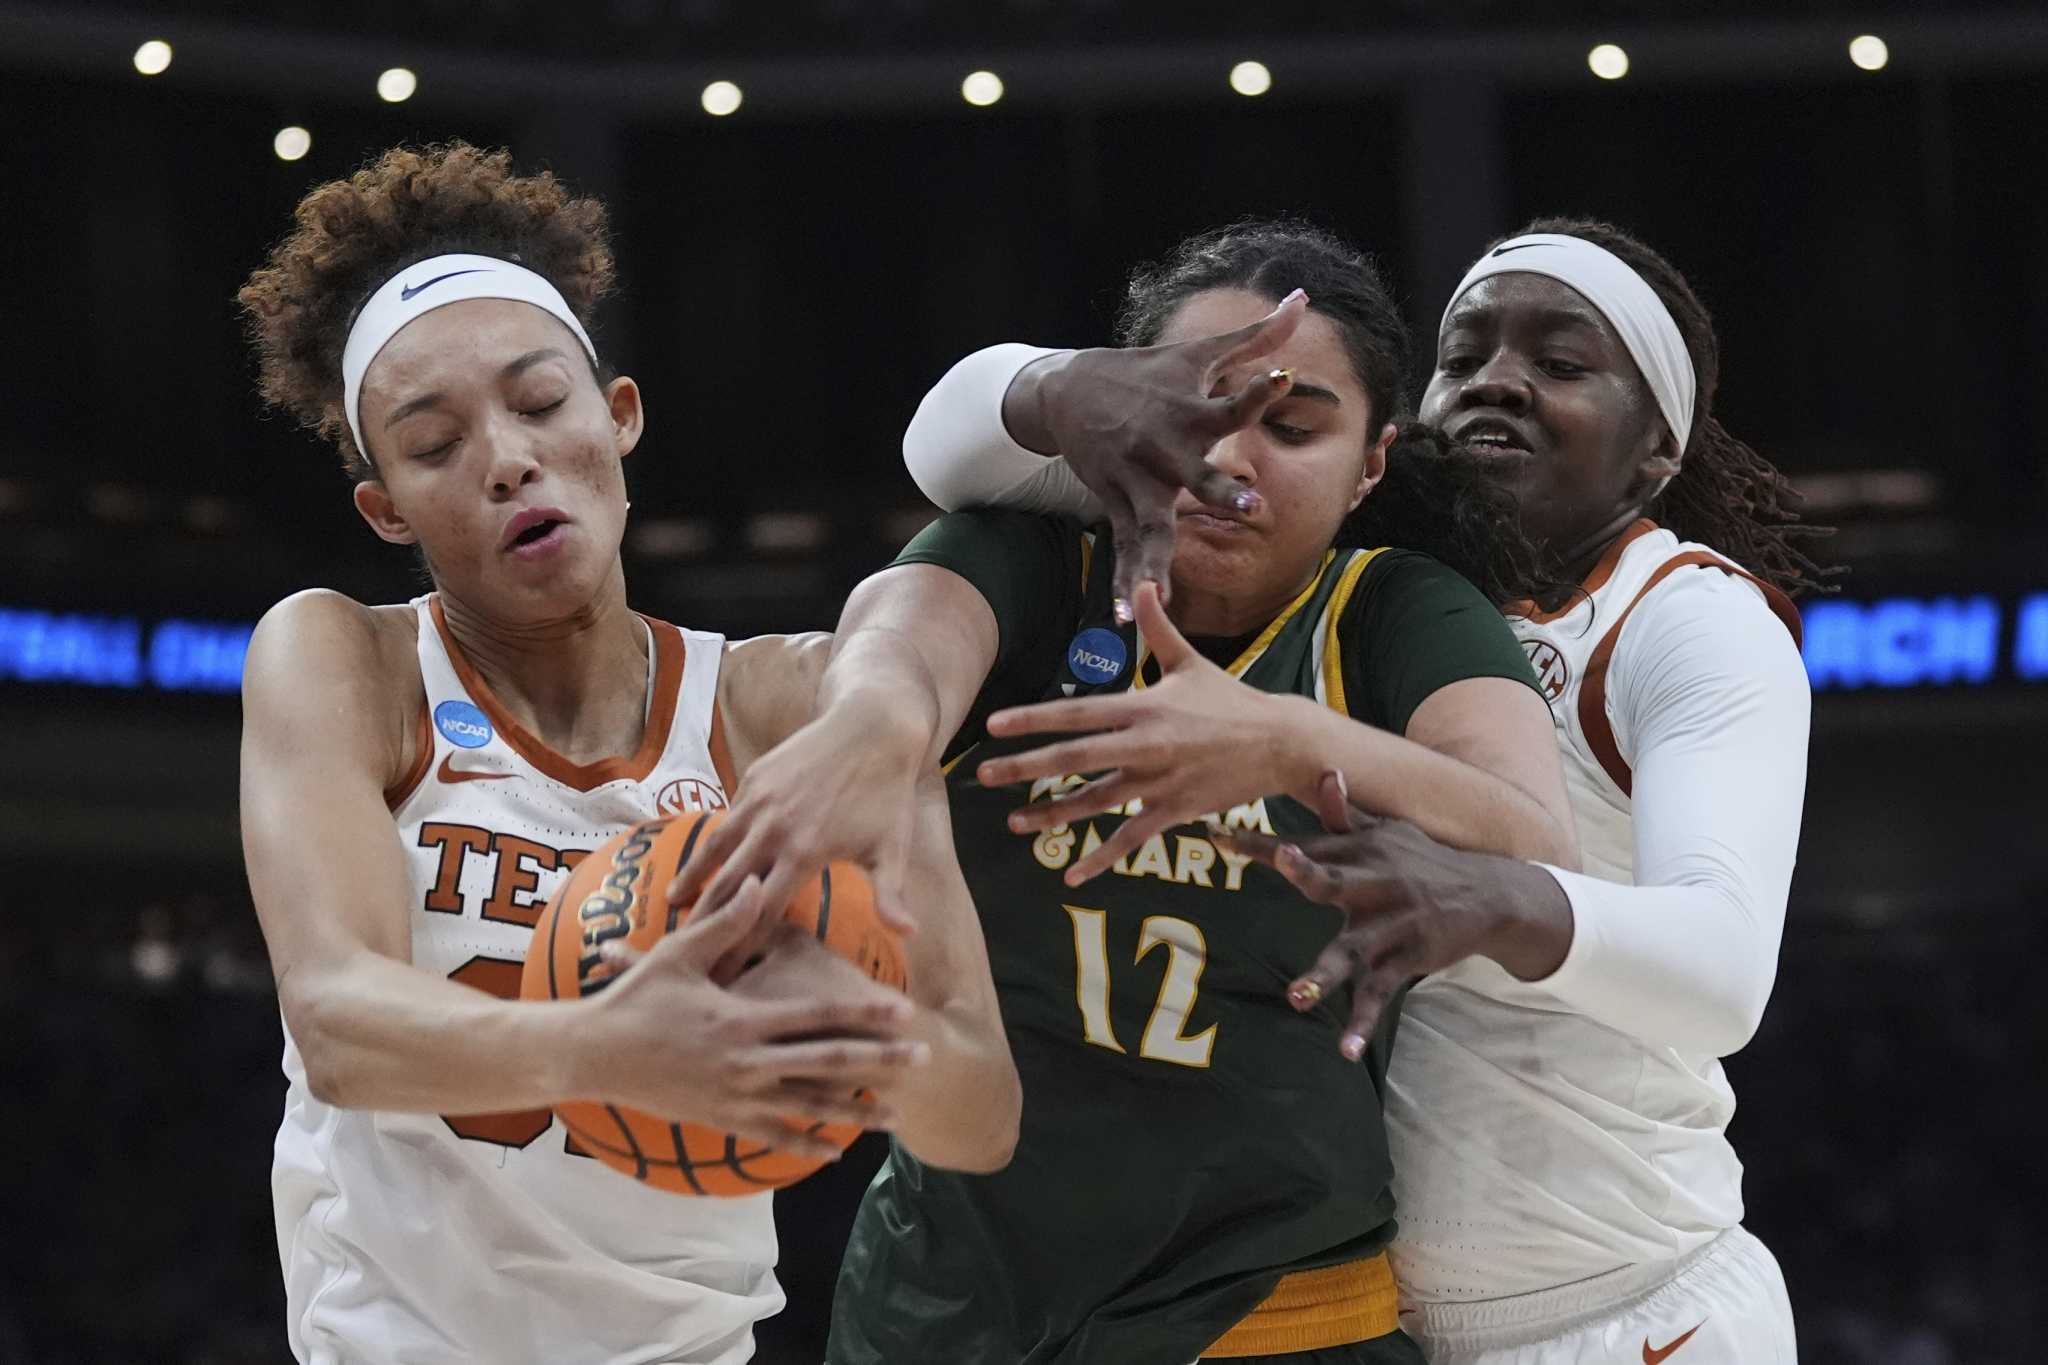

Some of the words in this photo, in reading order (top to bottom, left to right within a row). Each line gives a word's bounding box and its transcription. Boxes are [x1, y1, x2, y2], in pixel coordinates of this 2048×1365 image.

[1072, 648, 1120, 676] NCAA
[441, 718, 489, 739] NCAA
[418, 821, 594, 928] TE
[1061, 903, 1218, 1068] 12
